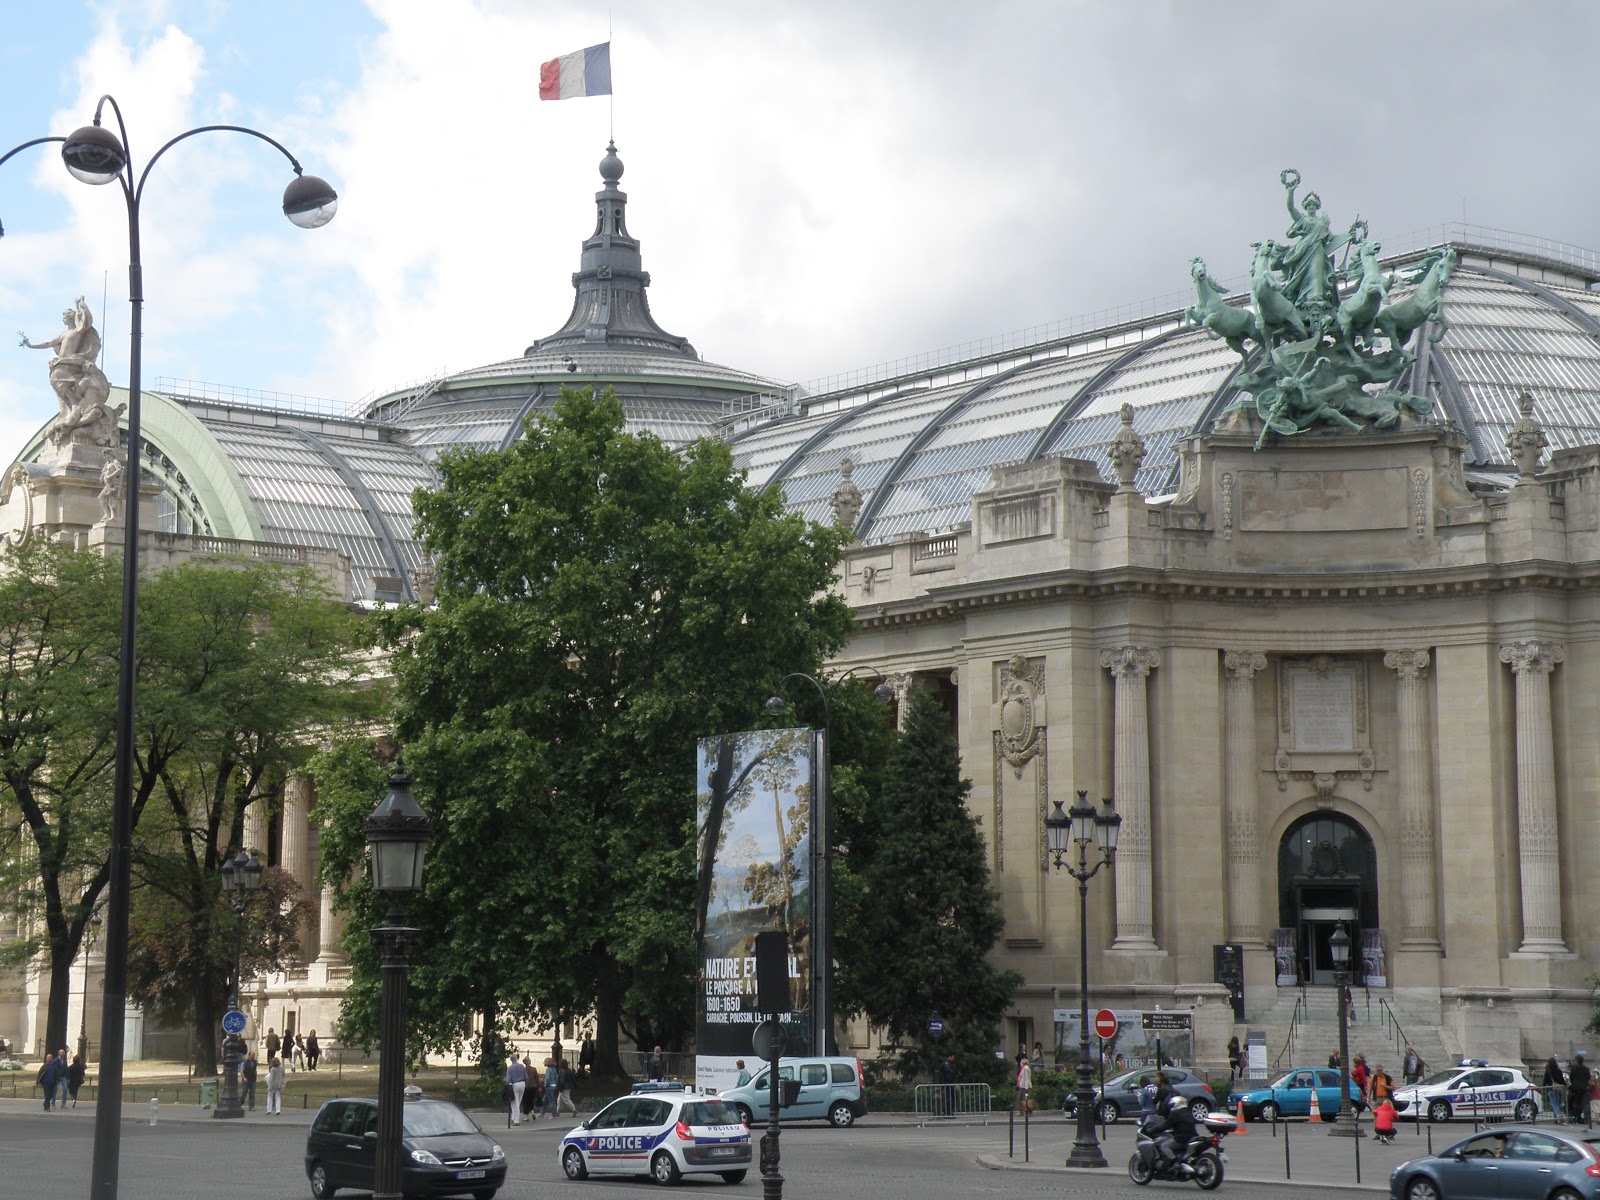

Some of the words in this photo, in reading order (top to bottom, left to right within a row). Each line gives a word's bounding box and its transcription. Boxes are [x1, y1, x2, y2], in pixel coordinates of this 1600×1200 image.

[705, 958, 740, 979] NATURE
[743, 956, 757, 978] ET
[705, 980, 713, 995] LE
[713, 980, 744, 995] PAYSAGE
[745, 978, 752, 995] À
[706, 996, 741, 1012] 1600-1650
[730, 1012, 754, 1024] POUSSIN,
[1464, 1092, 1506, 1102] POLICE
[598, 1136, 642, 1150] POLICE
